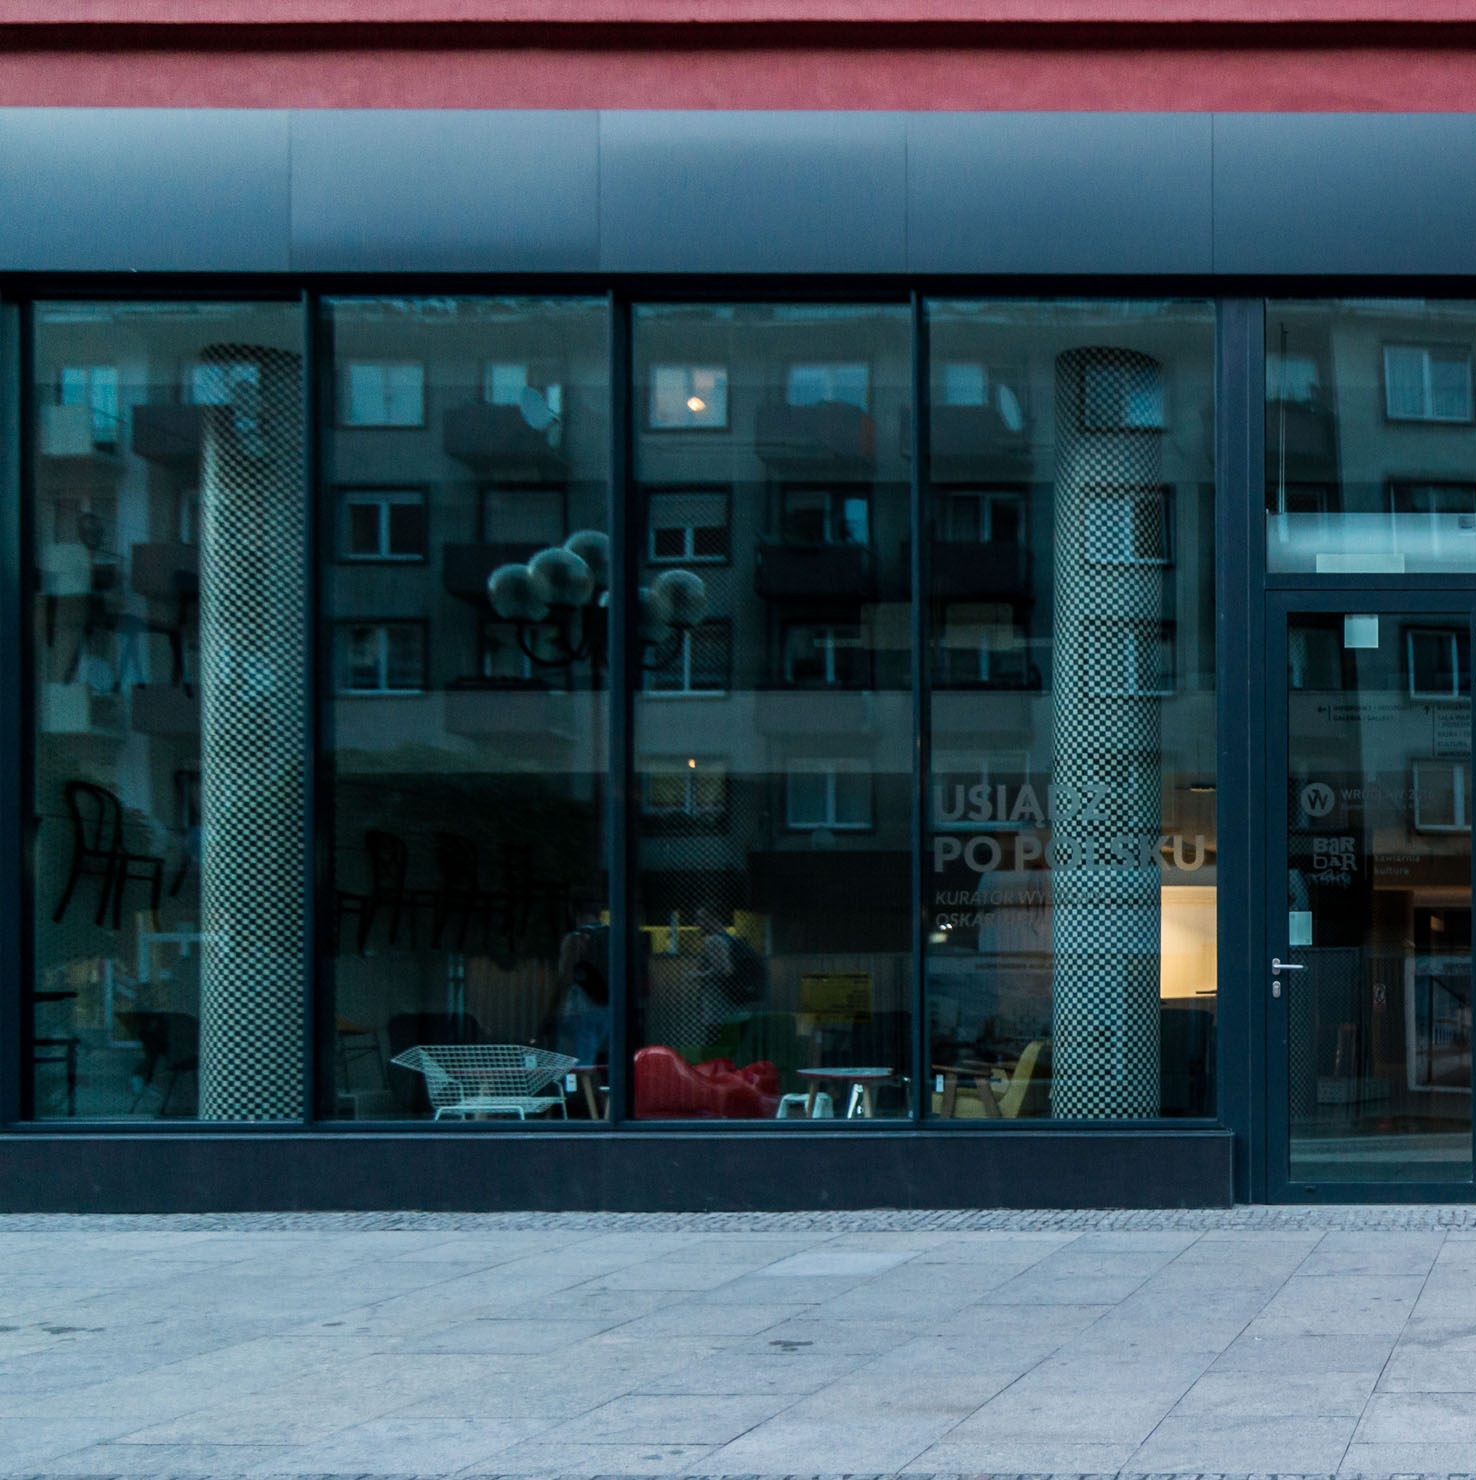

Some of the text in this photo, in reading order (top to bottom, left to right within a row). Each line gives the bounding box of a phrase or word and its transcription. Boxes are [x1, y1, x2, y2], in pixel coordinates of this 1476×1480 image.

[934, 835, 1205, 872] PO POLSKU
[935, 890, 1014, 905] KURATOR
[935, 912, 994, 928] OSKAR
